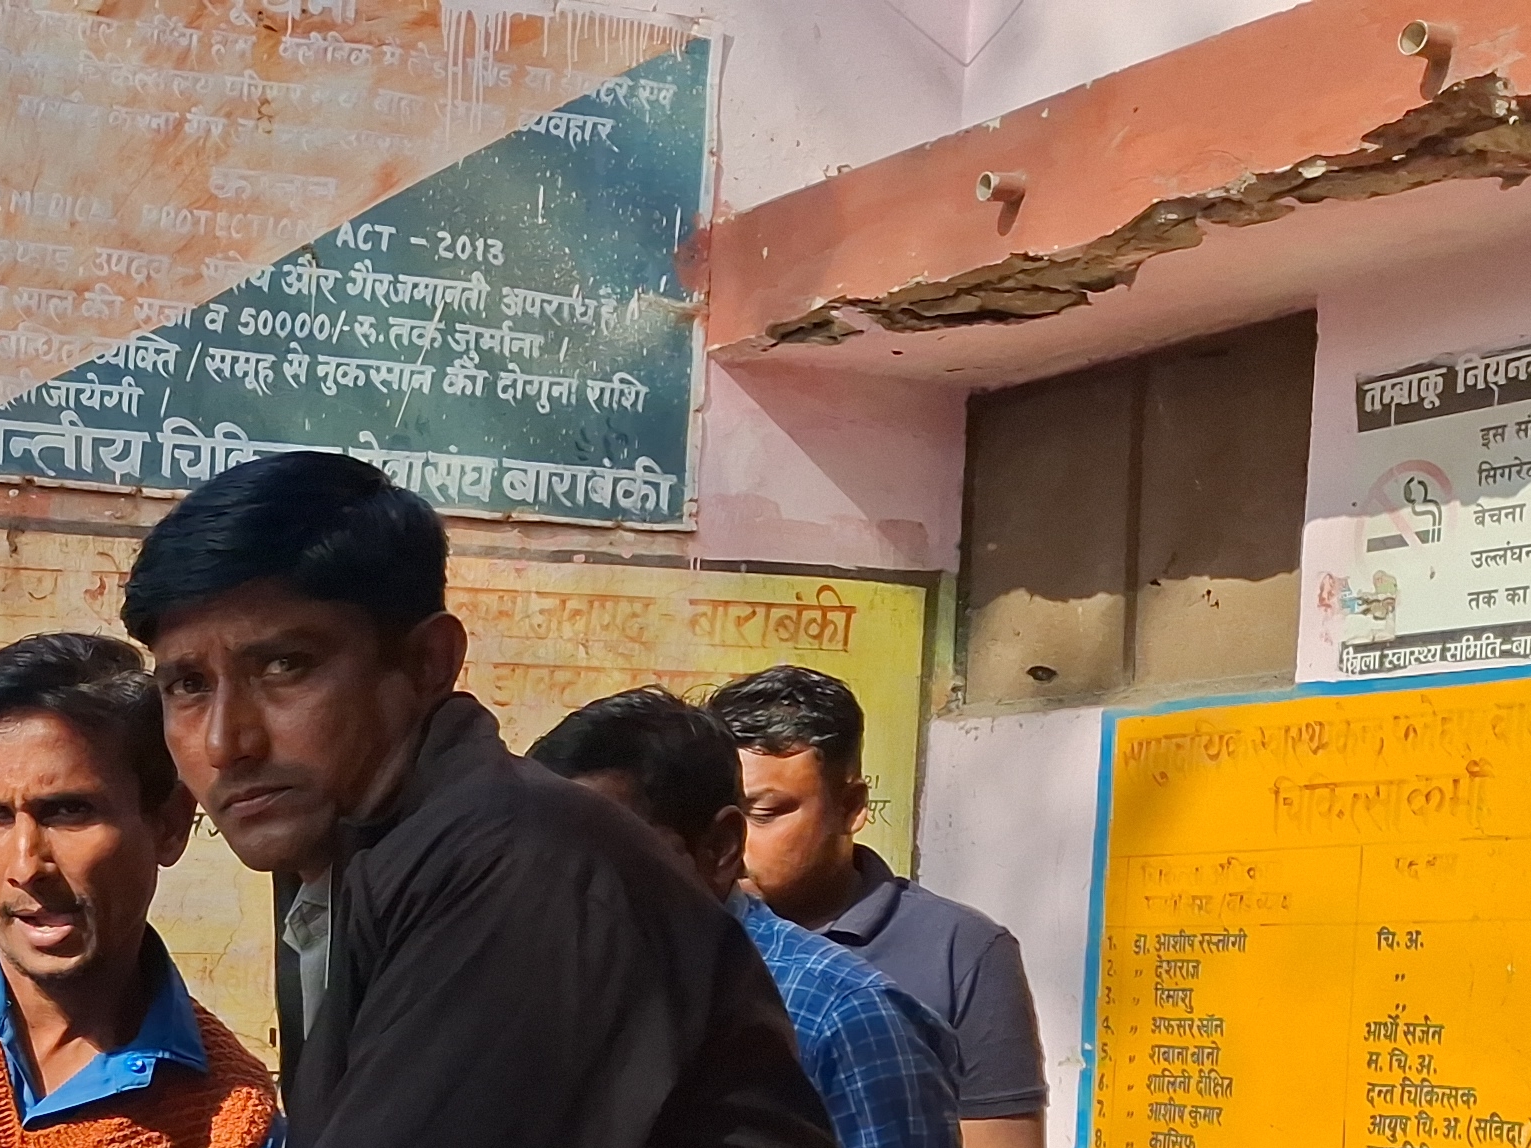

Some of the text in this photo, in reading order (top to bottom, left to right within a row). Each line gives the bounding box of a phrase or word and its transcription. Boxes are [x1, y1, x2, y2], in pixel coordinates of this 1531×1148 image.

[337, 222, 396, 252] ACT
[435, 230, 505, 266] 2013
[281, 252, 343, 304] और
[204, 303, 228, 334] व
[389, 316, 447, 352] तक
[204, 347, 276, 396] समूह
[282, 340, 308, 388] से
[1362, 367, 1448, 413] तम्बाकू
[1480, 424, 1507, 450] इस
[502, 456, 676, 513] बाराबंकी
[1473, 502, 1527, 528] बेचना
[1467, 589, 1499, 612] तक
[1384, 643, 1443, 668] स्वास्थ्य
[1154, 928, 1197, 953] आशीष
[1199, 927, 1248, 954] रस्तोगी
[1402, 1013, 1446, 1047] सर्जन
[1195, 1067, 1234, 1099] दीक्षित
[1399, 1075, 1478, 1112] चिकित्सक
[1189, 1104, 1223, 1129] कुमार
[1367, 1113, 1412, 1144] आयुष
